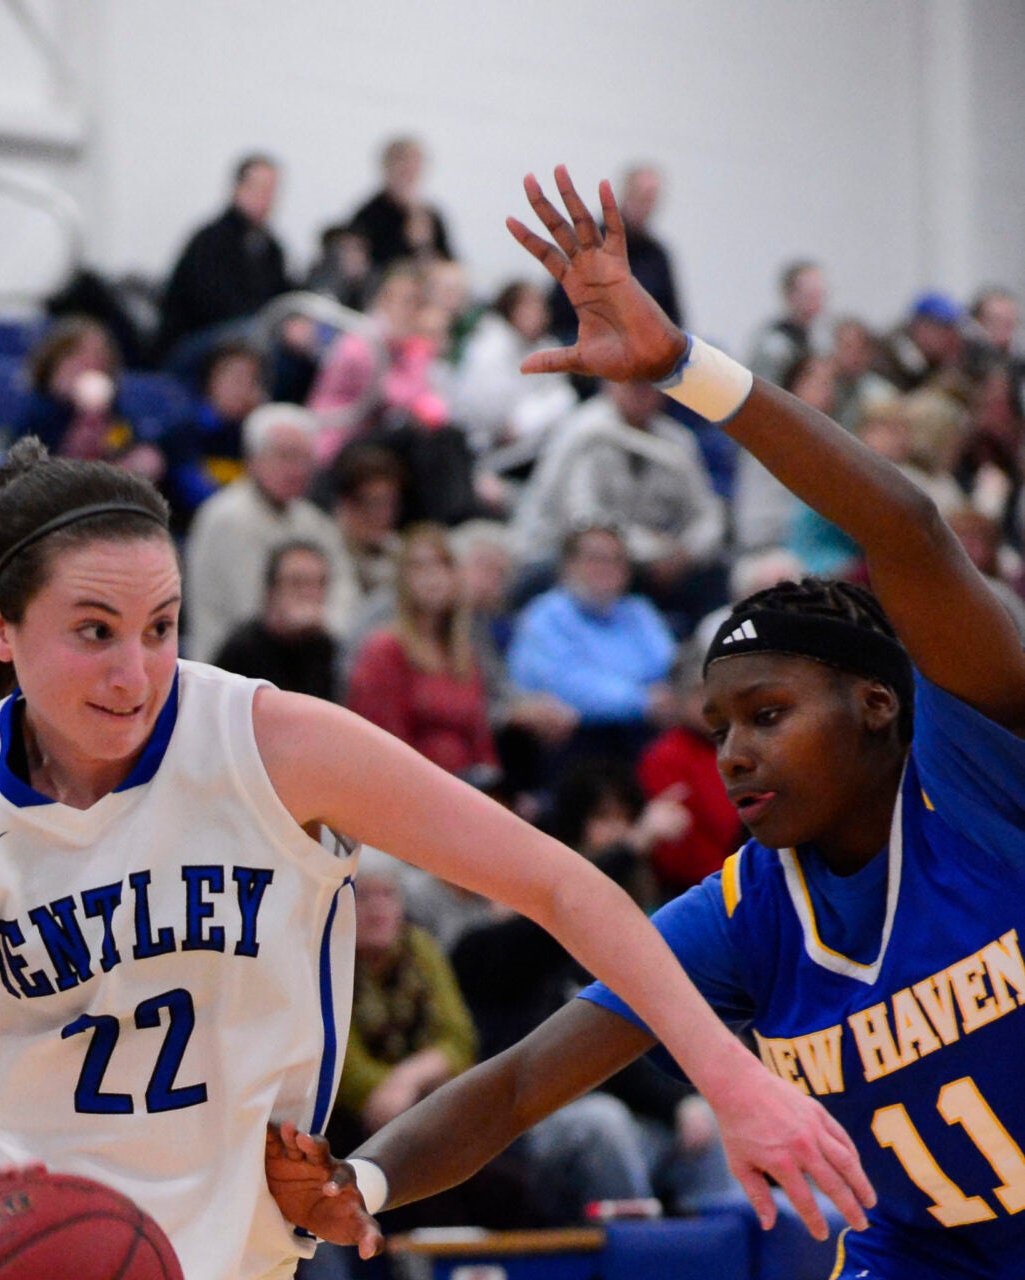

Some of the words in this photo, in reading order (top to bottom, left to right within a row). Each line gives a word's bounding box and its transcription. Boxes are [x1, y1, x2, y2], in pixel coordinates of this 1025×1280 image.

[61, 987, 208, 1115] 22
[847, 928, 1025, 1083] HAVEN
[871, 1075, 1025, 1228] 11
